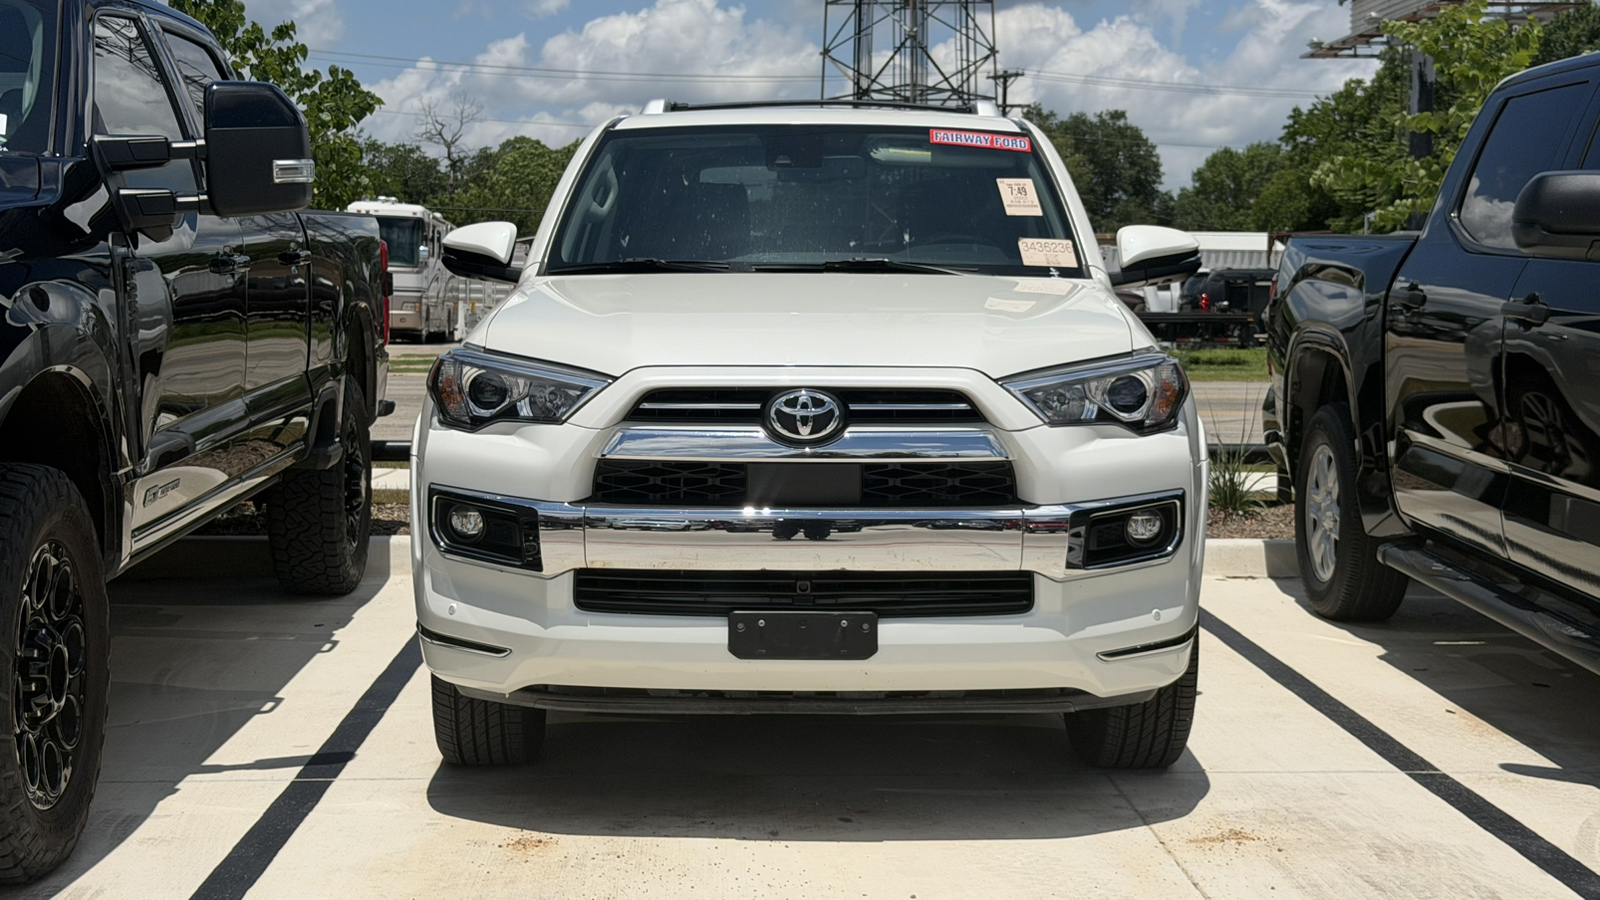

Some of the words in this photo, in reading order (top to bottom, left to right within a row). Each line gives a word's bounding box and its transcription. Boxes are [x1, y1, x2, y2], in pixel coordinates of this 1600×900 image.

[934, 132, 991, 145] FAIRWAY
[995, 137, 1027, 149] FORD
[1008, 186, 1028, 196] 7:49
[1021, 241, 1072, 253] 3436236
